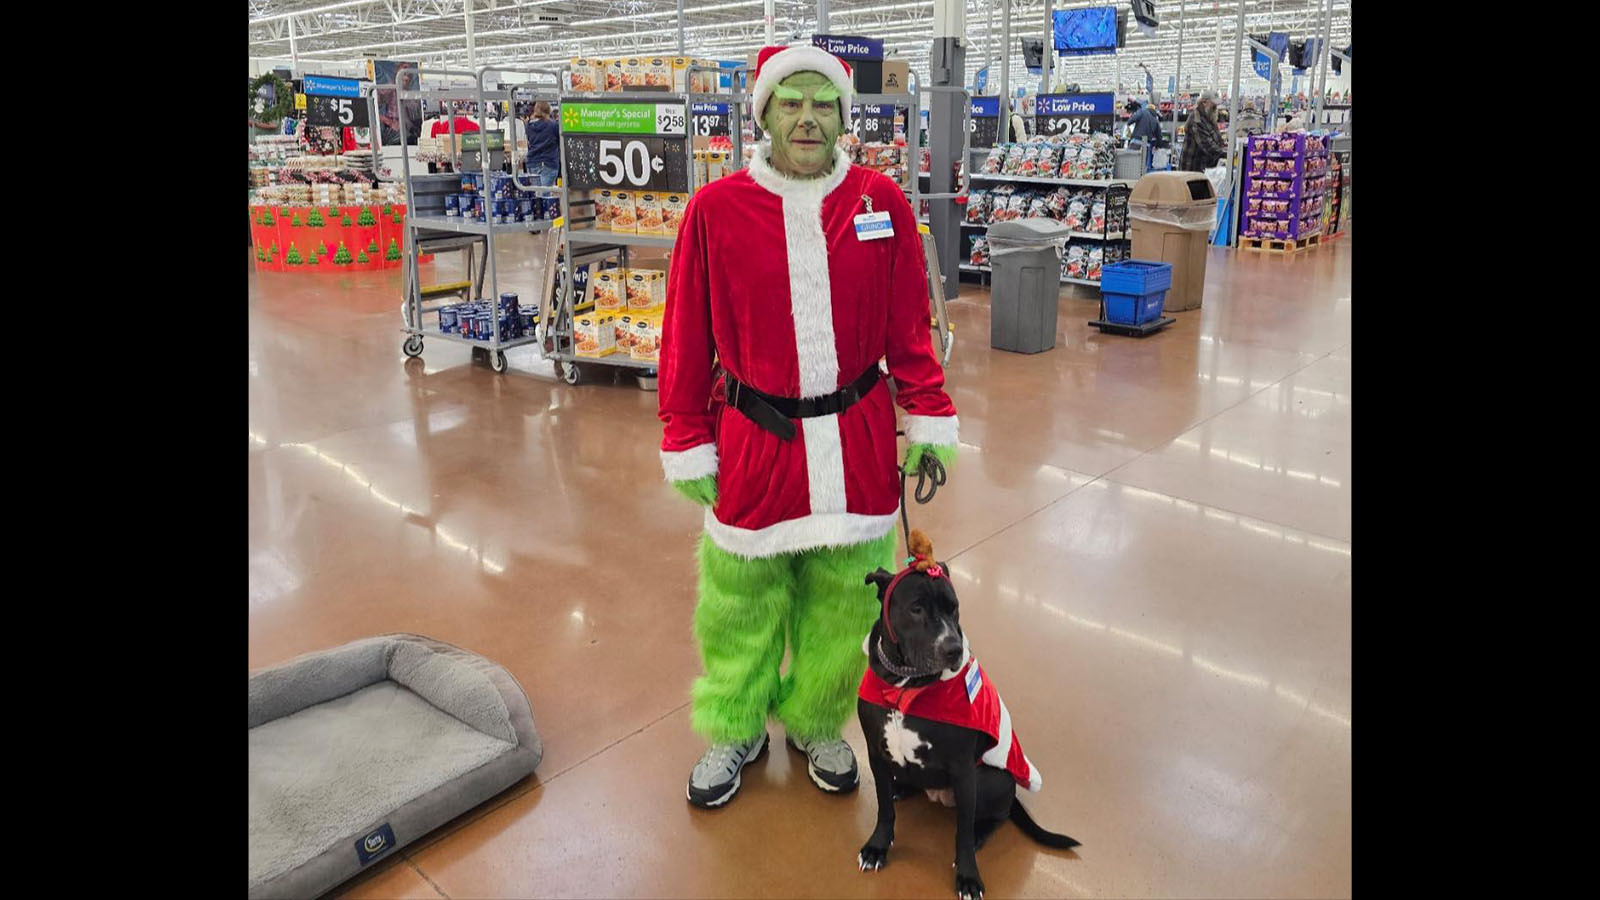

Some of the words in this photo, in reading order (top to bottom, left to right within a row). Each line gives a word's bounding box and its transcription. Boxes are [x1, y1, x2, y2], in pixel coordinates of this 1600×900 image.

[828, 44, 846, 53] Low
[847, 44, 869, 54] Price
[330, 98, 354, 124] $5
[691, 103, 703, 111] Low
[703, 103, 718, 111] Price
[1052, 102, 1071, 112] Low
[1072, 101, 1095, 111] Price
[581, 108, 620, 120] Manager's
[622, 109, 651, 120] Special
